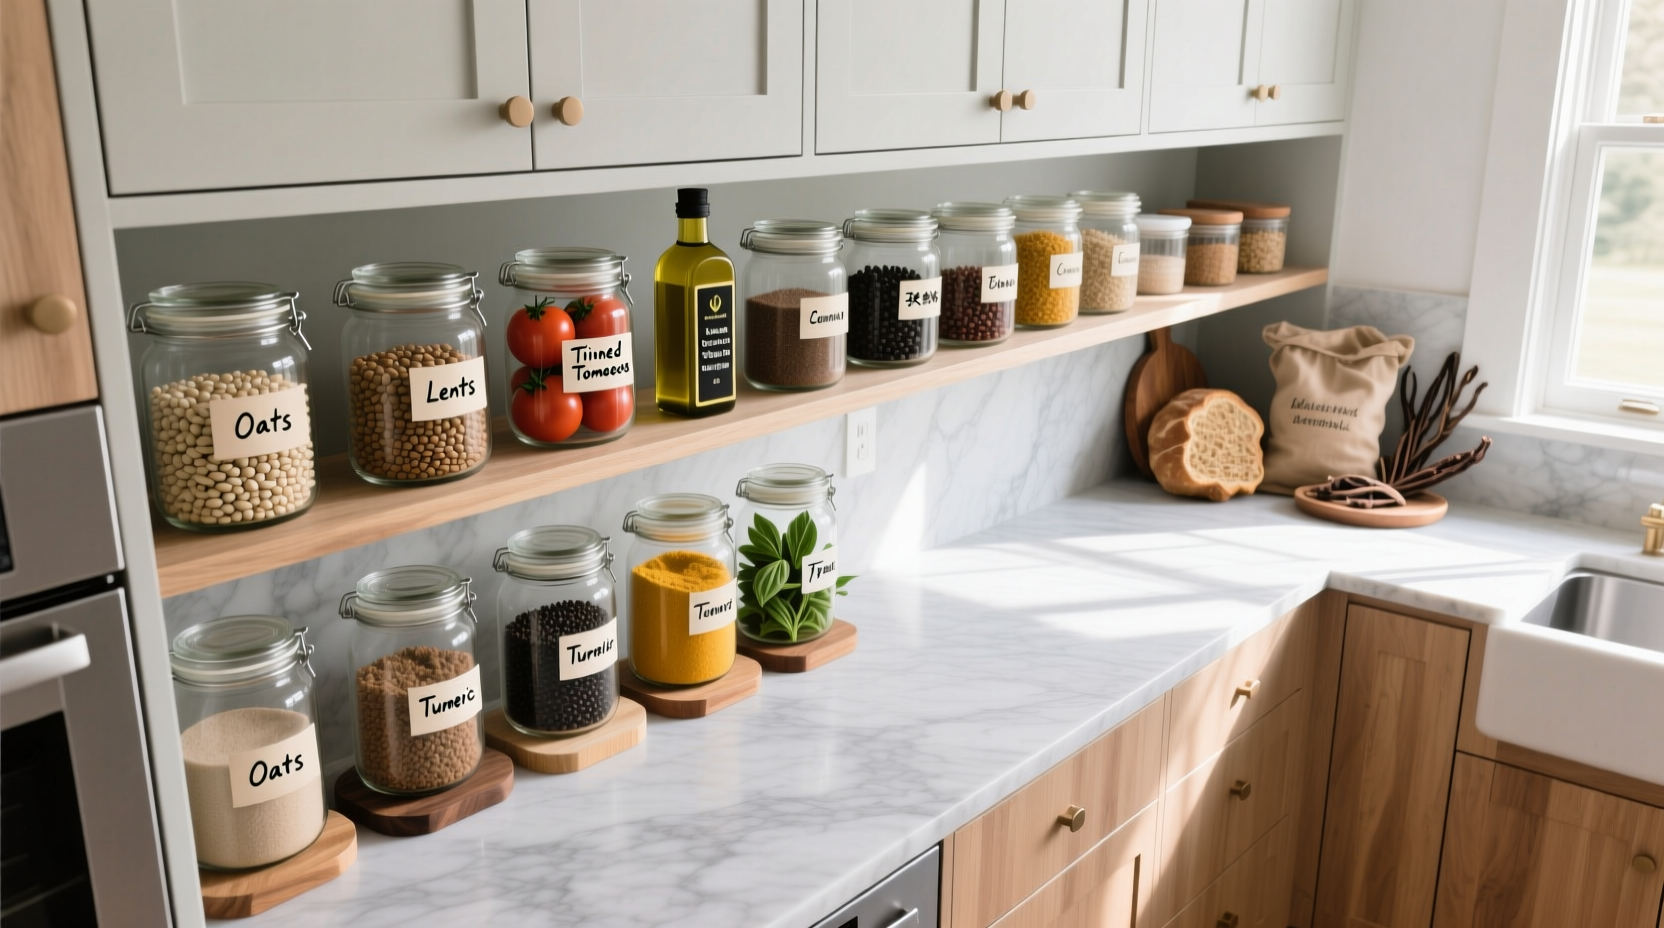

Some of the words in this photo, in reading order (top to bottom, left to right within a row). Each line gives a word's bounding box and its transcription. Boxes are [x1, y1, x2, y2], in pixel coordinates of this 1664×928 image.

[426, 376, 476, 404] Lents
[235, 408, 292, 440] Oats
[249, 753, 304, 787] Oats
